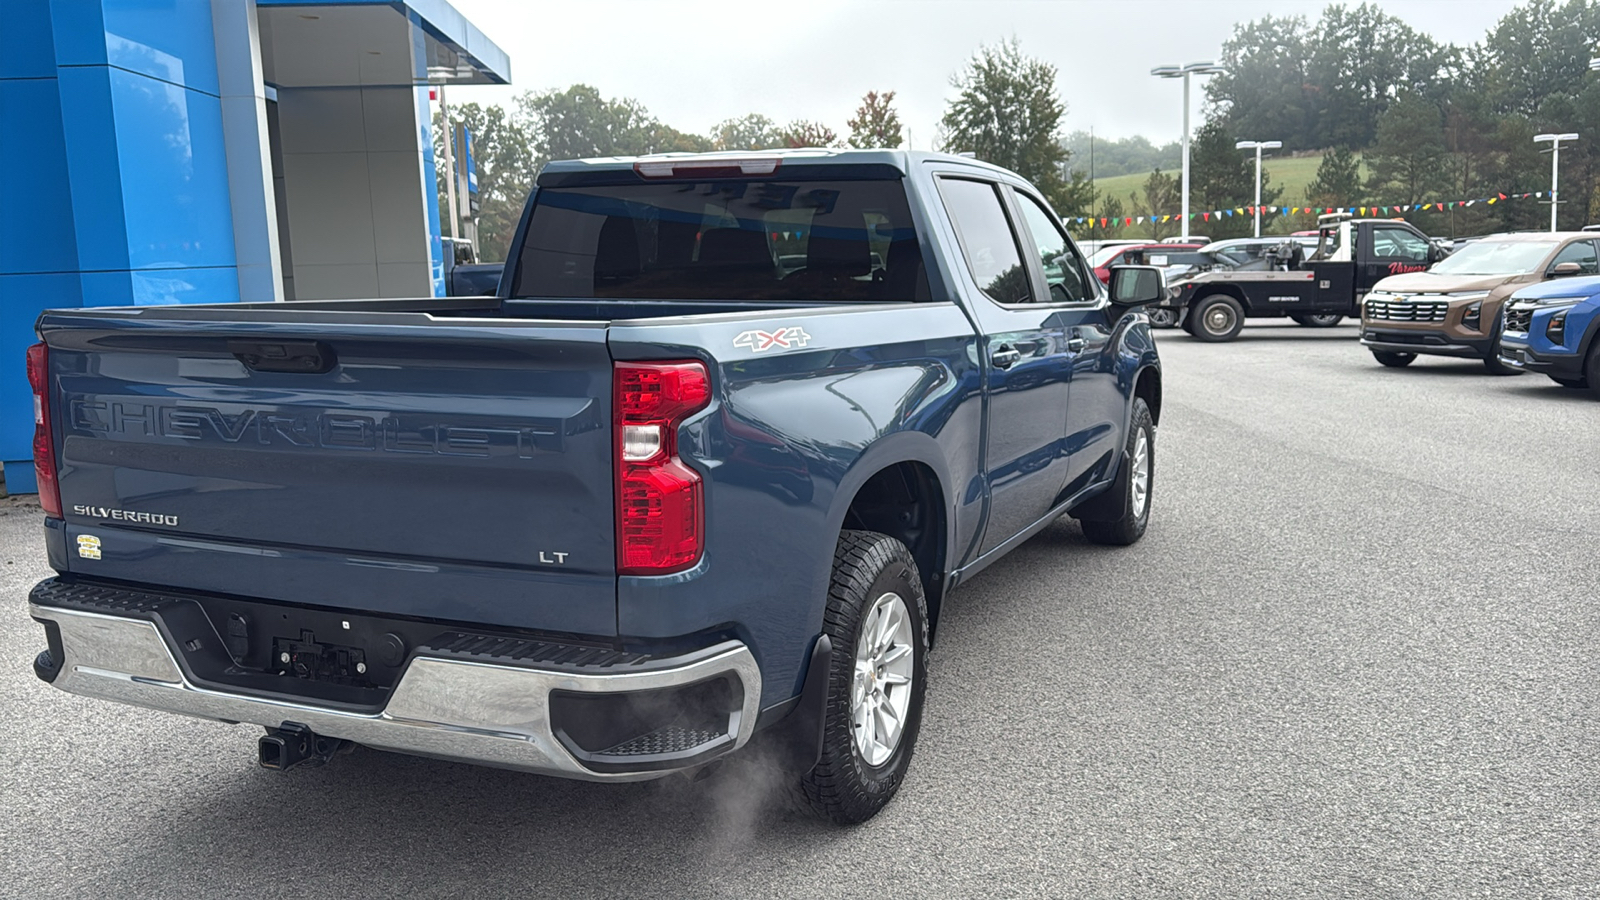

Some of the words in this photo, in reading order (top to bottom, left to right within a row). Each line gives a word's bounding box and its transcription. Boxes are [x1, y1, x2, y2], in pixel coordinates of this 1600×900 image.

[70, 399, 556, 459] CHEVROLET
[74, 505, 178, 526] SILVERADO
[539, 551, 569, 564] LT
